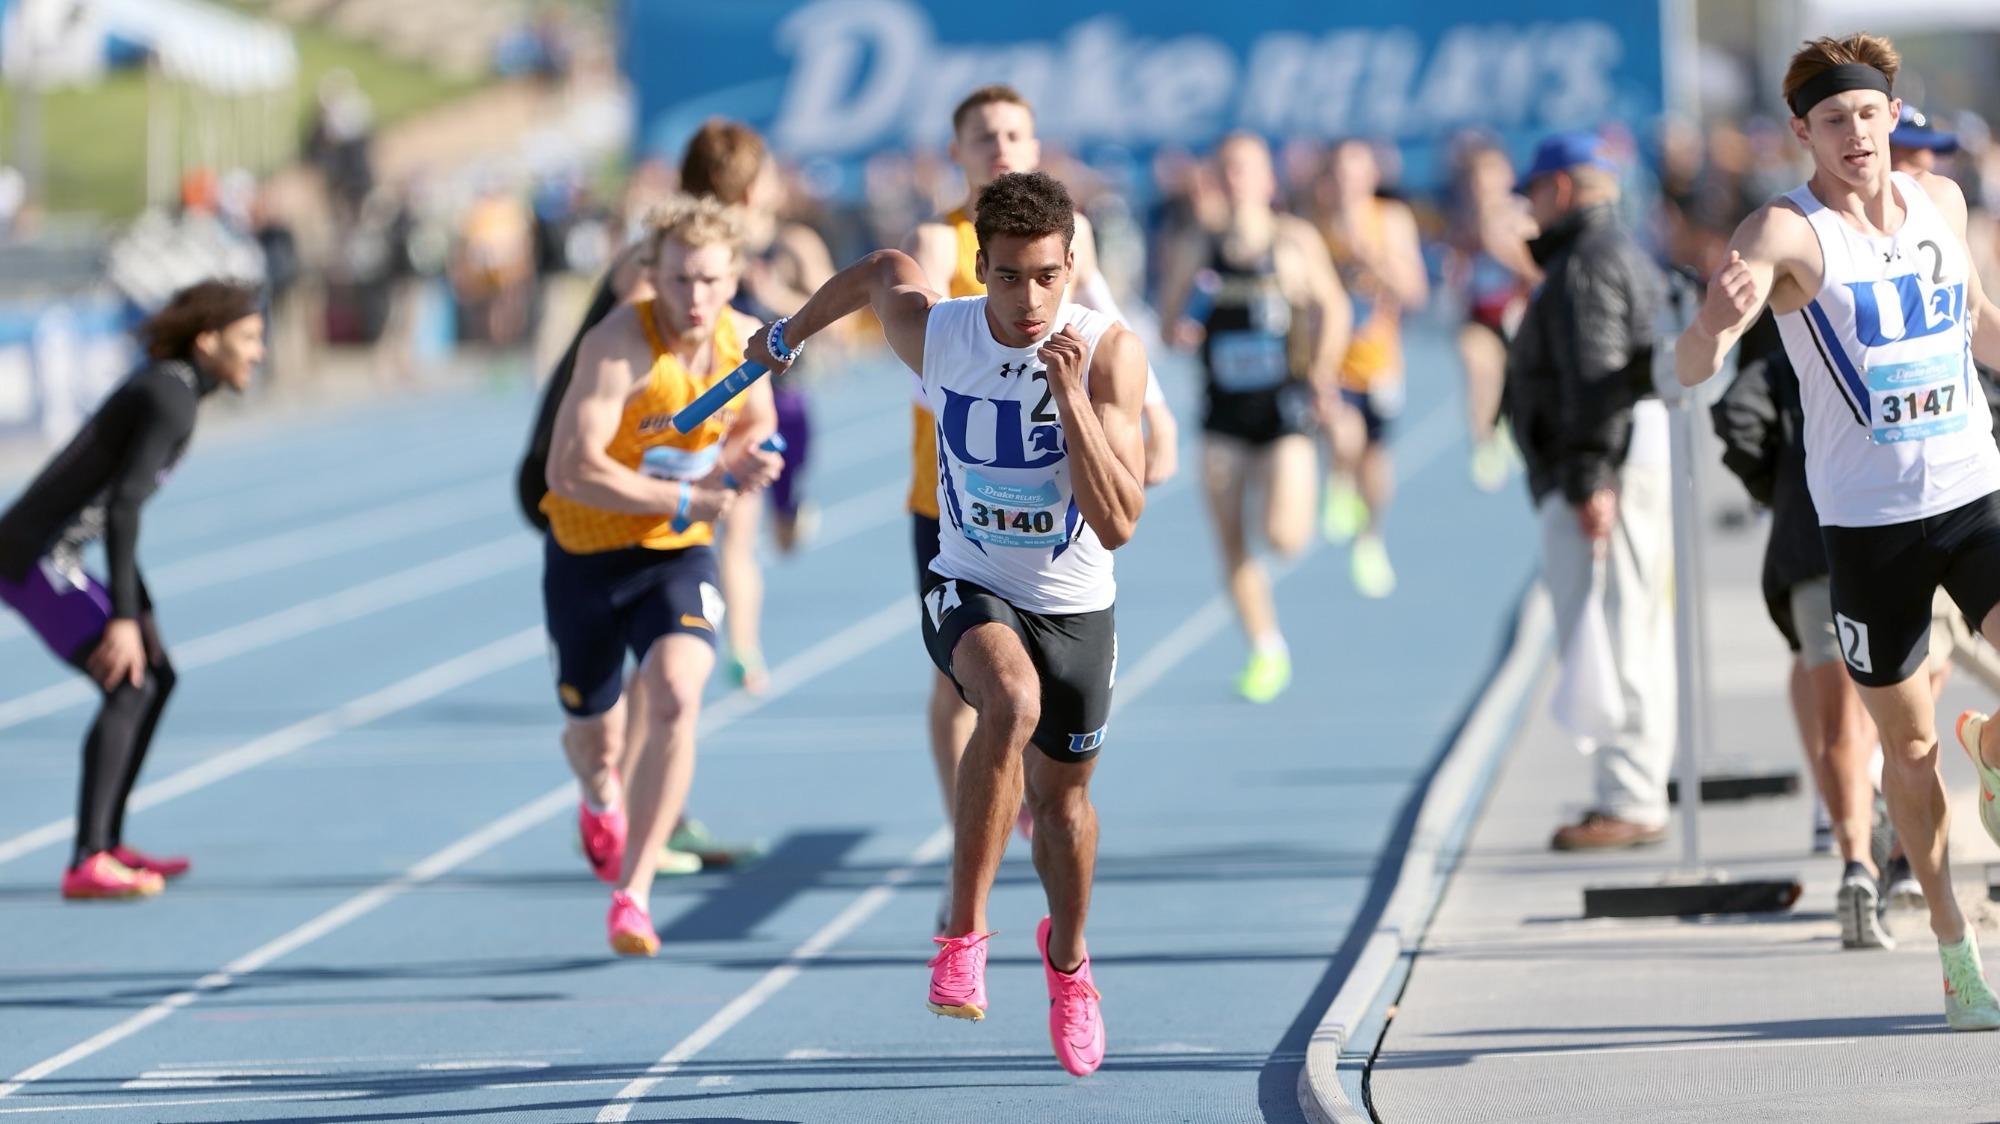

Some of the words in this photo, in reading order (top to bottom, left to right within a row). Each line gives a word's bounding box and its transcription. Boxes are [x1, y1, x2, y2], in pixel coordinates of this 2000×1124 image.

[1918, 240, 1947, 284] 2
[1030, 371, 1056, 422] 2
[1882, 384, 1955, 423] 3147
[982, 486, 1015, 499] Drake
[972, 502, 1053, 533] 3140
[1844, 621, 1865, 668] 2
